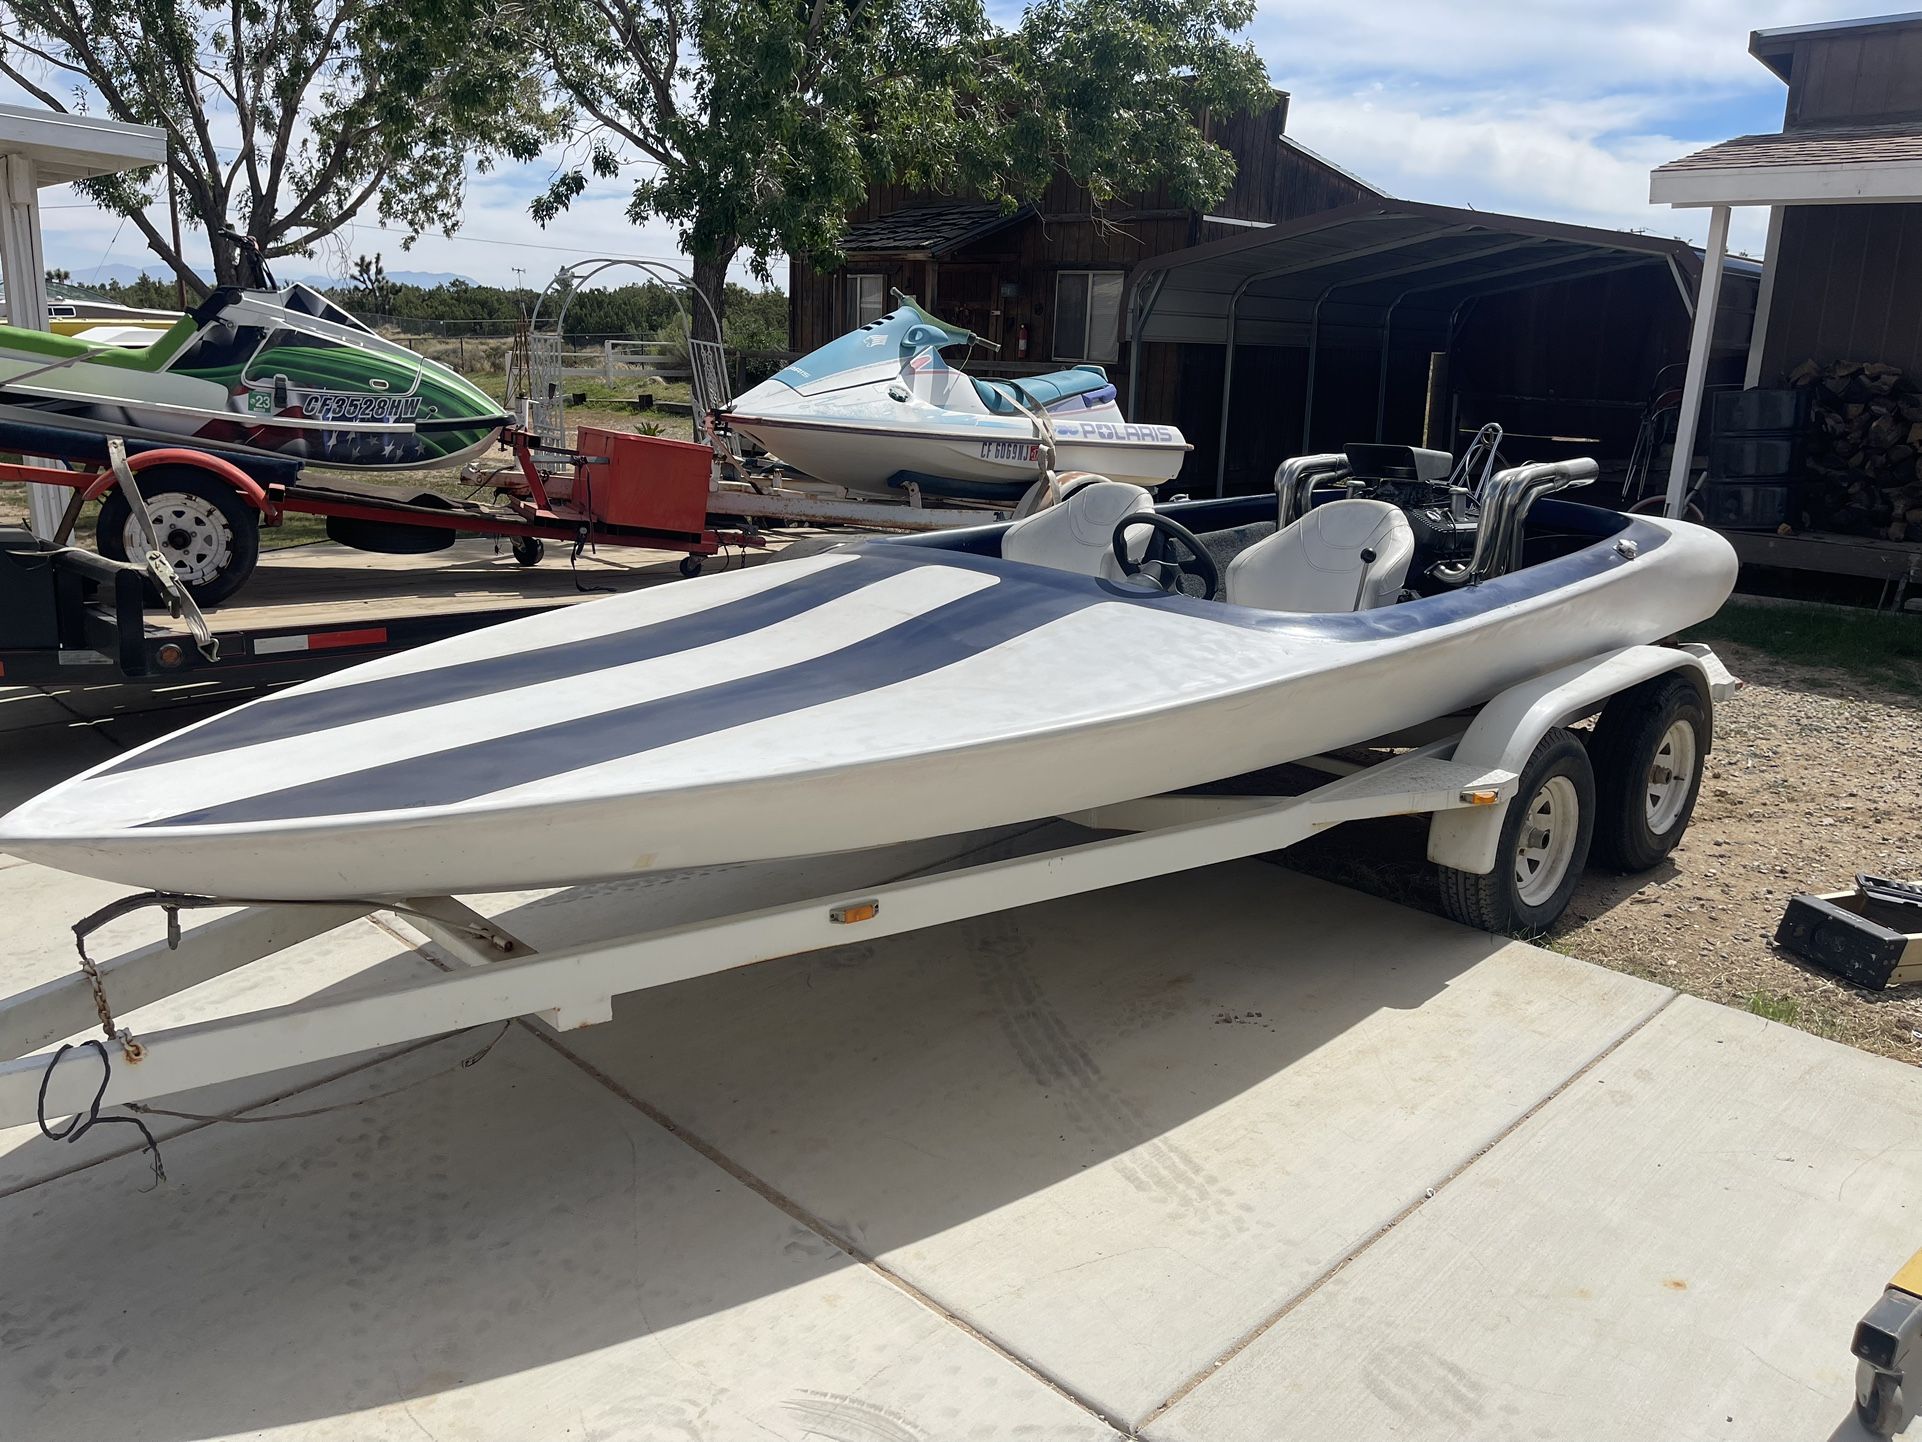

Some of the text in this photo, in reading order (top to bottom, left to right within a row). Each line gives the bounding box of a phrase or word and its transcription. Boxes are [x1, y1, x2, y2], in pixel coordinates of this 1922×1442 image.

[255, 395, 271, 409] 23
[303, 395, 422, 418] CF3528HW
[1080, 422, 1173, 442] POLARIS
[981, 441, 993, 459] CF
